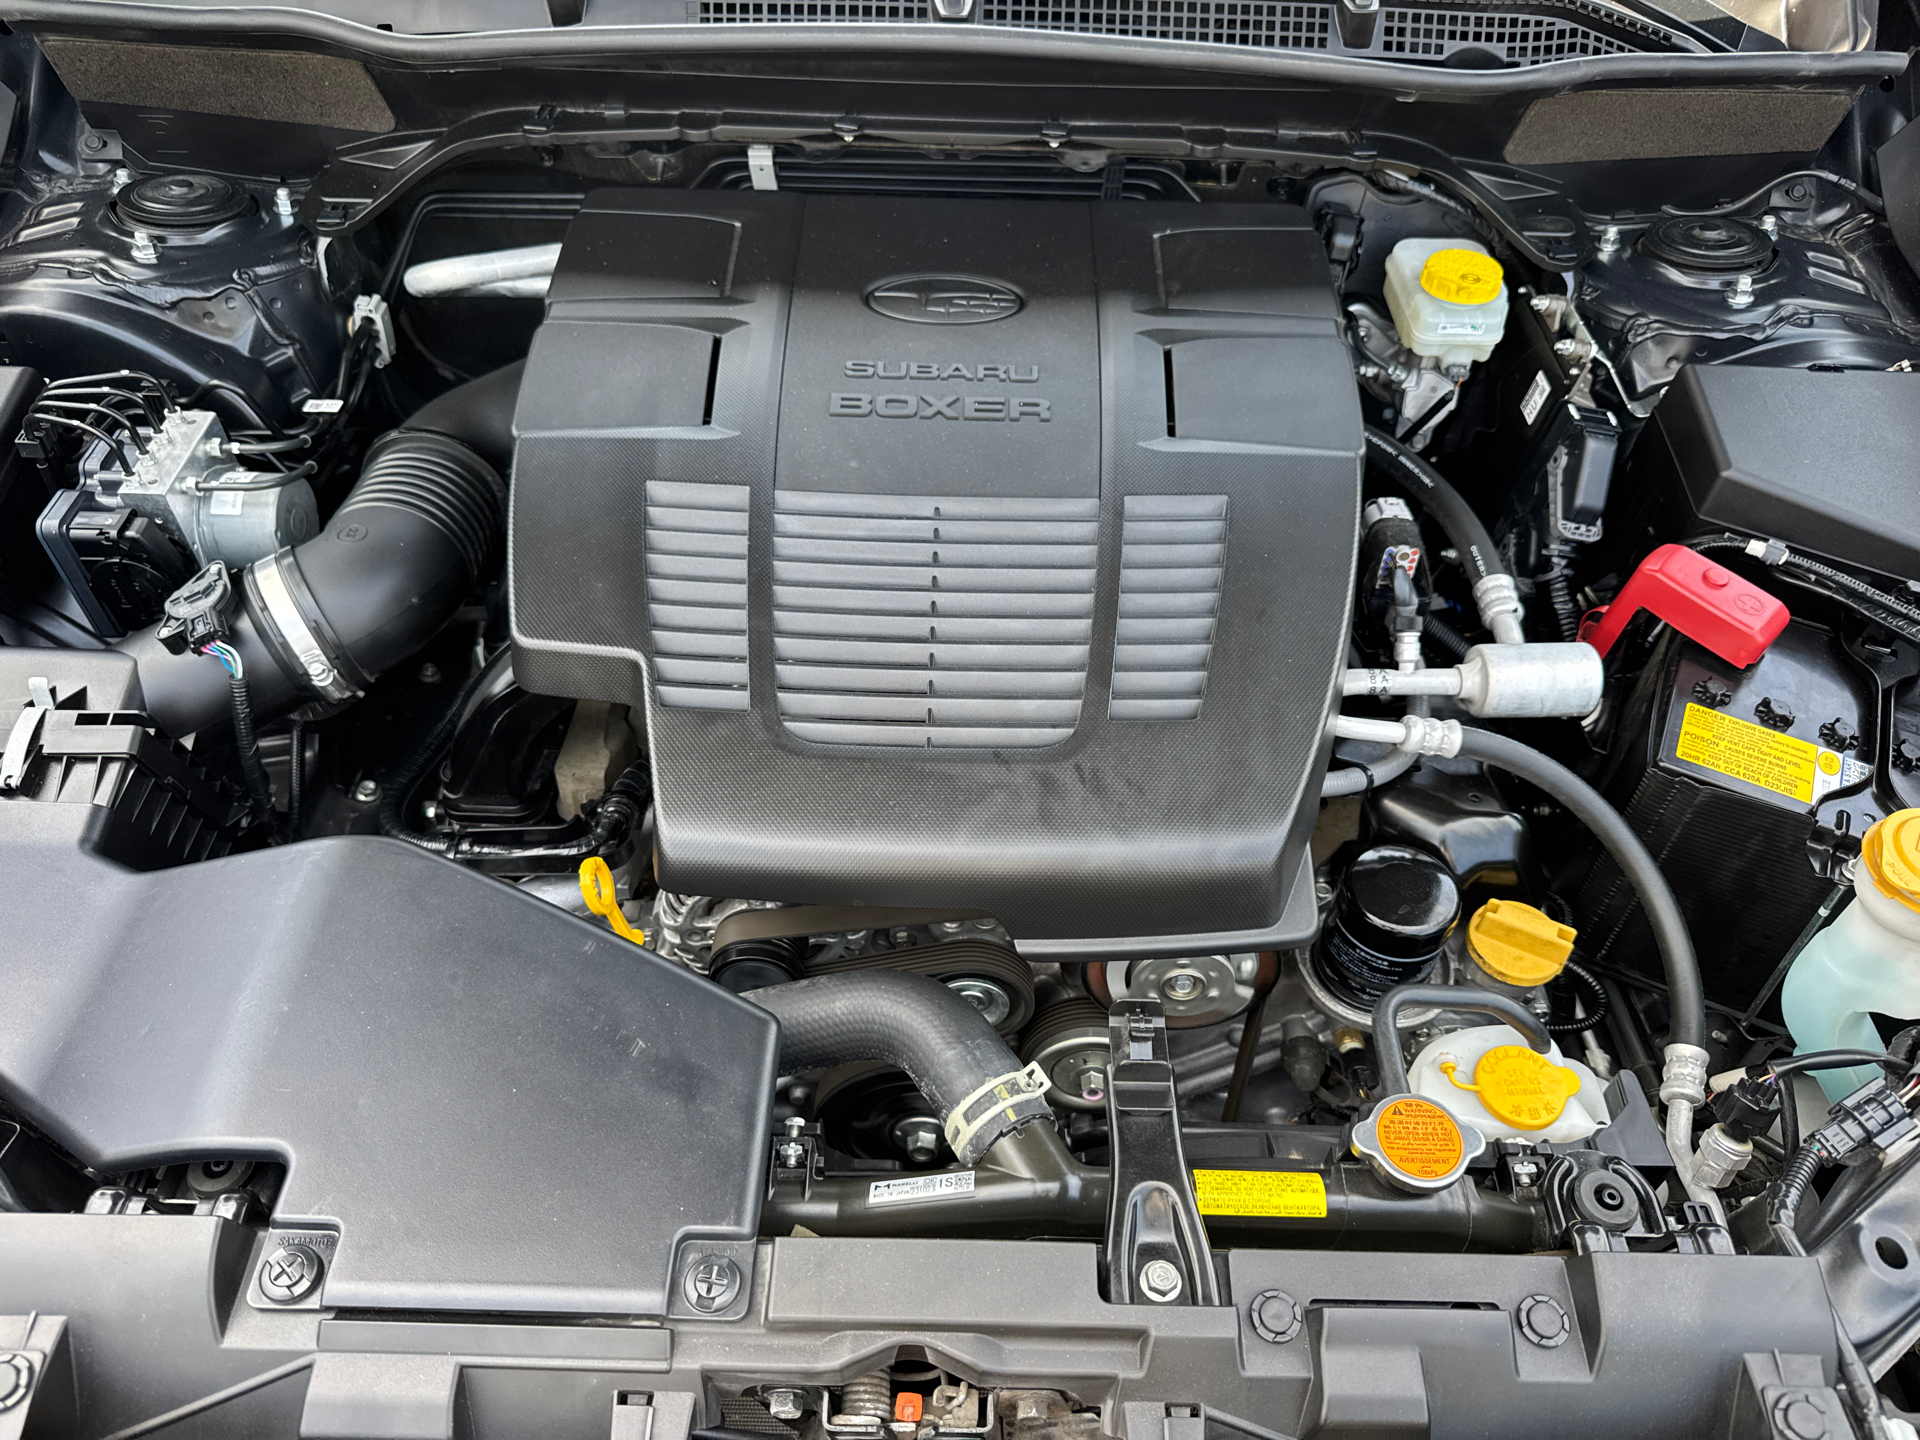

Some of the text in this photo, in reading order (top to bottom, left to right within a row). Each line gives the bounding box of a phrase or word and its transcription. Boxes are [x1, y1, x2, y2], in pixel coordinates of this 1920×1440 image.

[844, 360, 1039, 382] SUBARU
[829, 392, 1050, 422] BOXER
[1688, 705, 1776, 738] DANGER EXPLOSIVE GASES
[1683, 730, 1787, 770] POISON CAUSES SEVERE BURNS
[1679, 750, 1796, 796] 20HR 62Ah CCA 620A D23(JIS)
[1886, 861, 1912, 886] PULL
[1481, 1048, 1550, 1074] COOLANT
[1505, 1068, 1525, 1077] SEE
[1506, 1086, 1545, 1096] MANUAL
